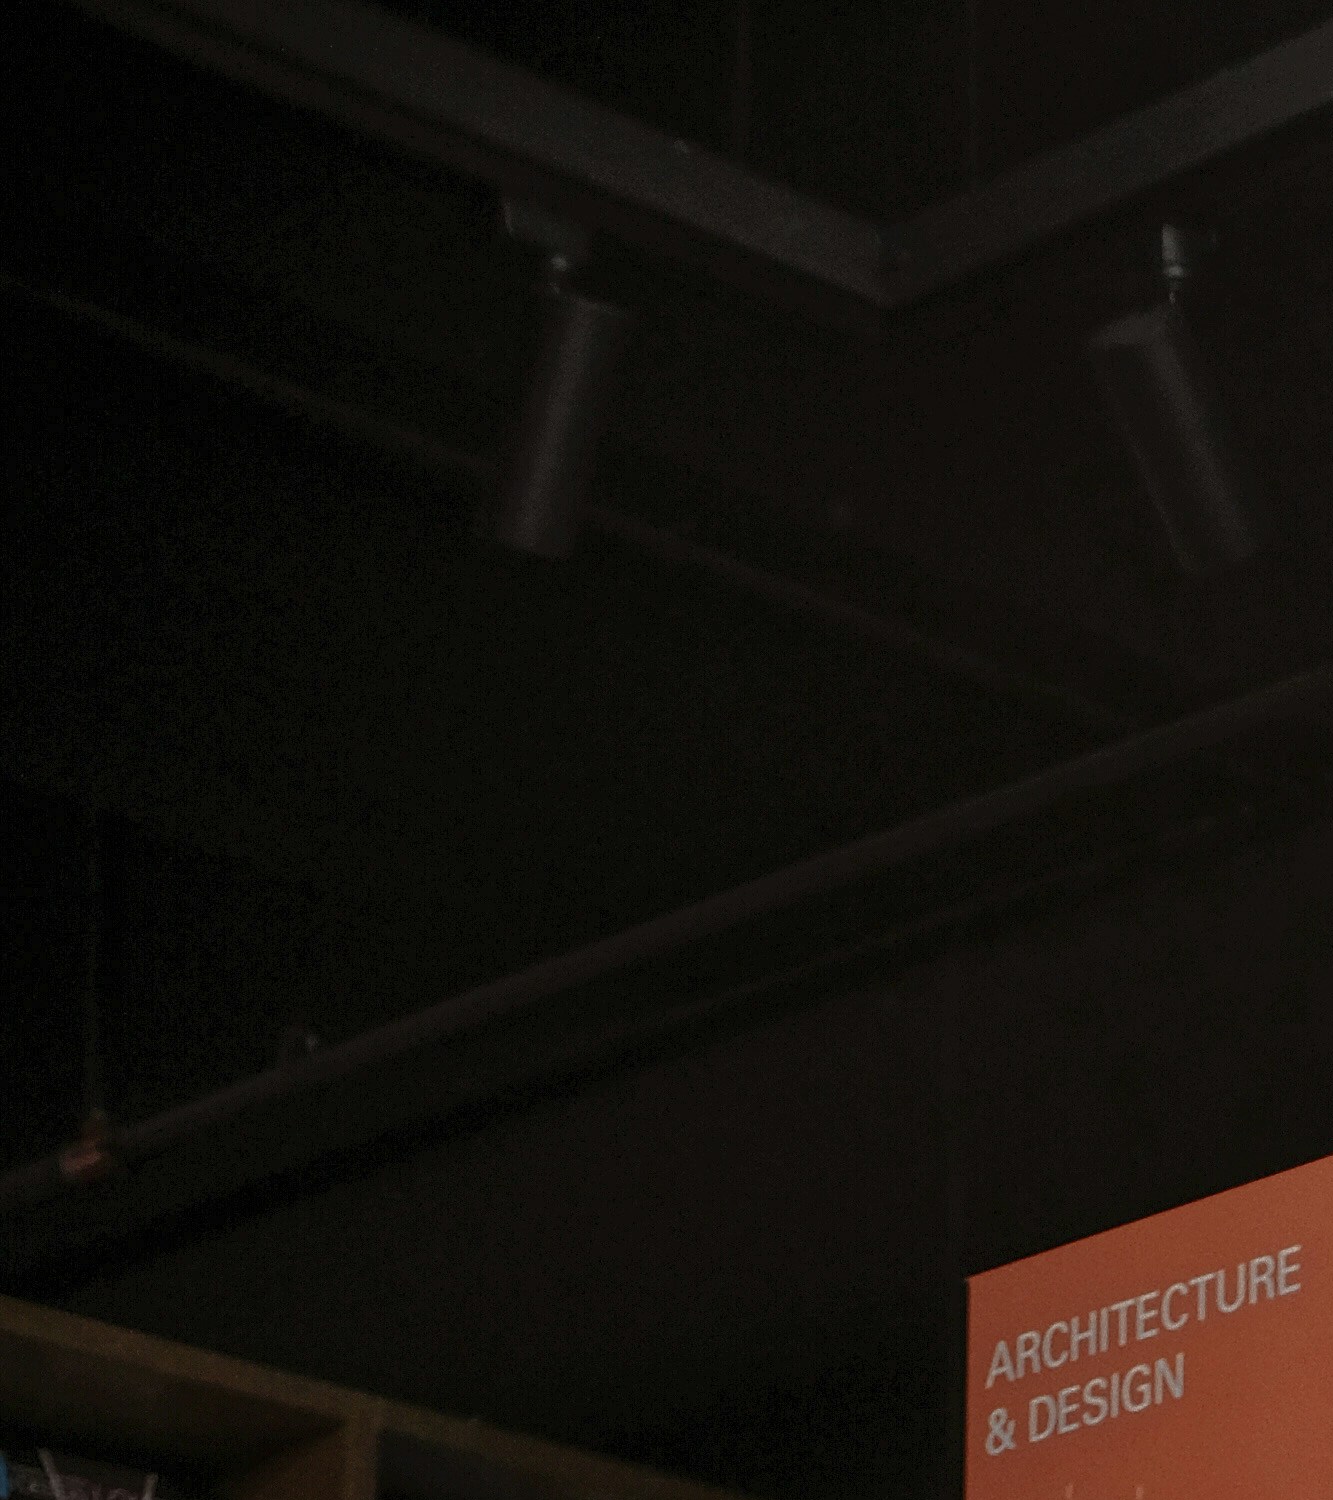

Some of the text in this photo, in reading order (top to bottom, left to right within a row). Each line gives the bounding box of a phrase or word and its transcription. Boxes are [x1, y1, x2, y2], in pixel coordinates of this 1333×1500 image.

[984, 1245, 1303, 1388] ARCHITECTURE
[984, 1351, 1187, 1457] & DESIGN
